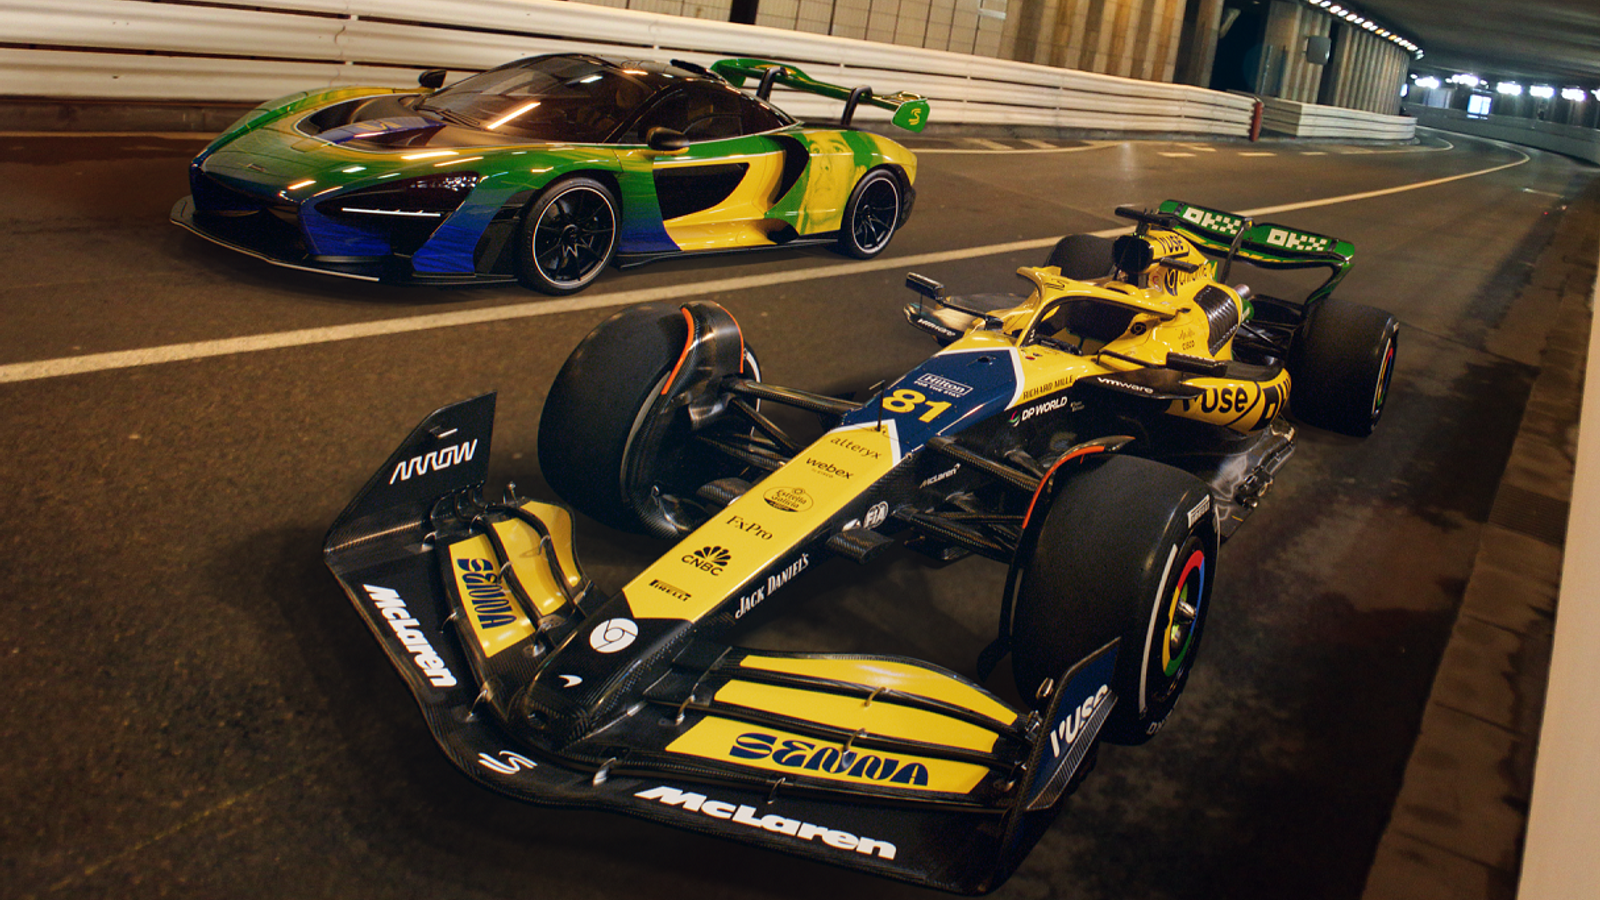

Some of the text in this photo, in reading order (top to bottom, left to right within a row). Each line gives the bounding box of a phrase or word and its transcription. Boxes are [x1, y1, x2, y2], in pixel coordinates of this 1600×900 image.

[1182, 206, 1242, 235] OKX
[1266, 228, 1328, 252] OKX
[924, 375, 965, 393] Hilton
[1022, 375, 1074, 400] RICHARD MILLE
[1097, 376, 1154, 394] vmware
[882, 389, 952, 424] 81
[1021, 407, 1036, 422] DP
[1035, 396, 1069, 417] WORLD
[830, 436, 882, 460] alteryx
[389, 438, 478, 485] ARROW
[805, 457, 855, 480] webex
[726, 515, 773, 541] FxPro
[681, 554, 724, 577] CNBC
[456, 557, 518, 630] SENNA
[648, 578, 692, 603] PIRELLI
[734, 553, 810, 620] JACK DANIEL'S
[362, 583, 458, 688] McLaren
[729, 732, 929, 787] SENNA
[633, 785, 897, 861] McLaren
